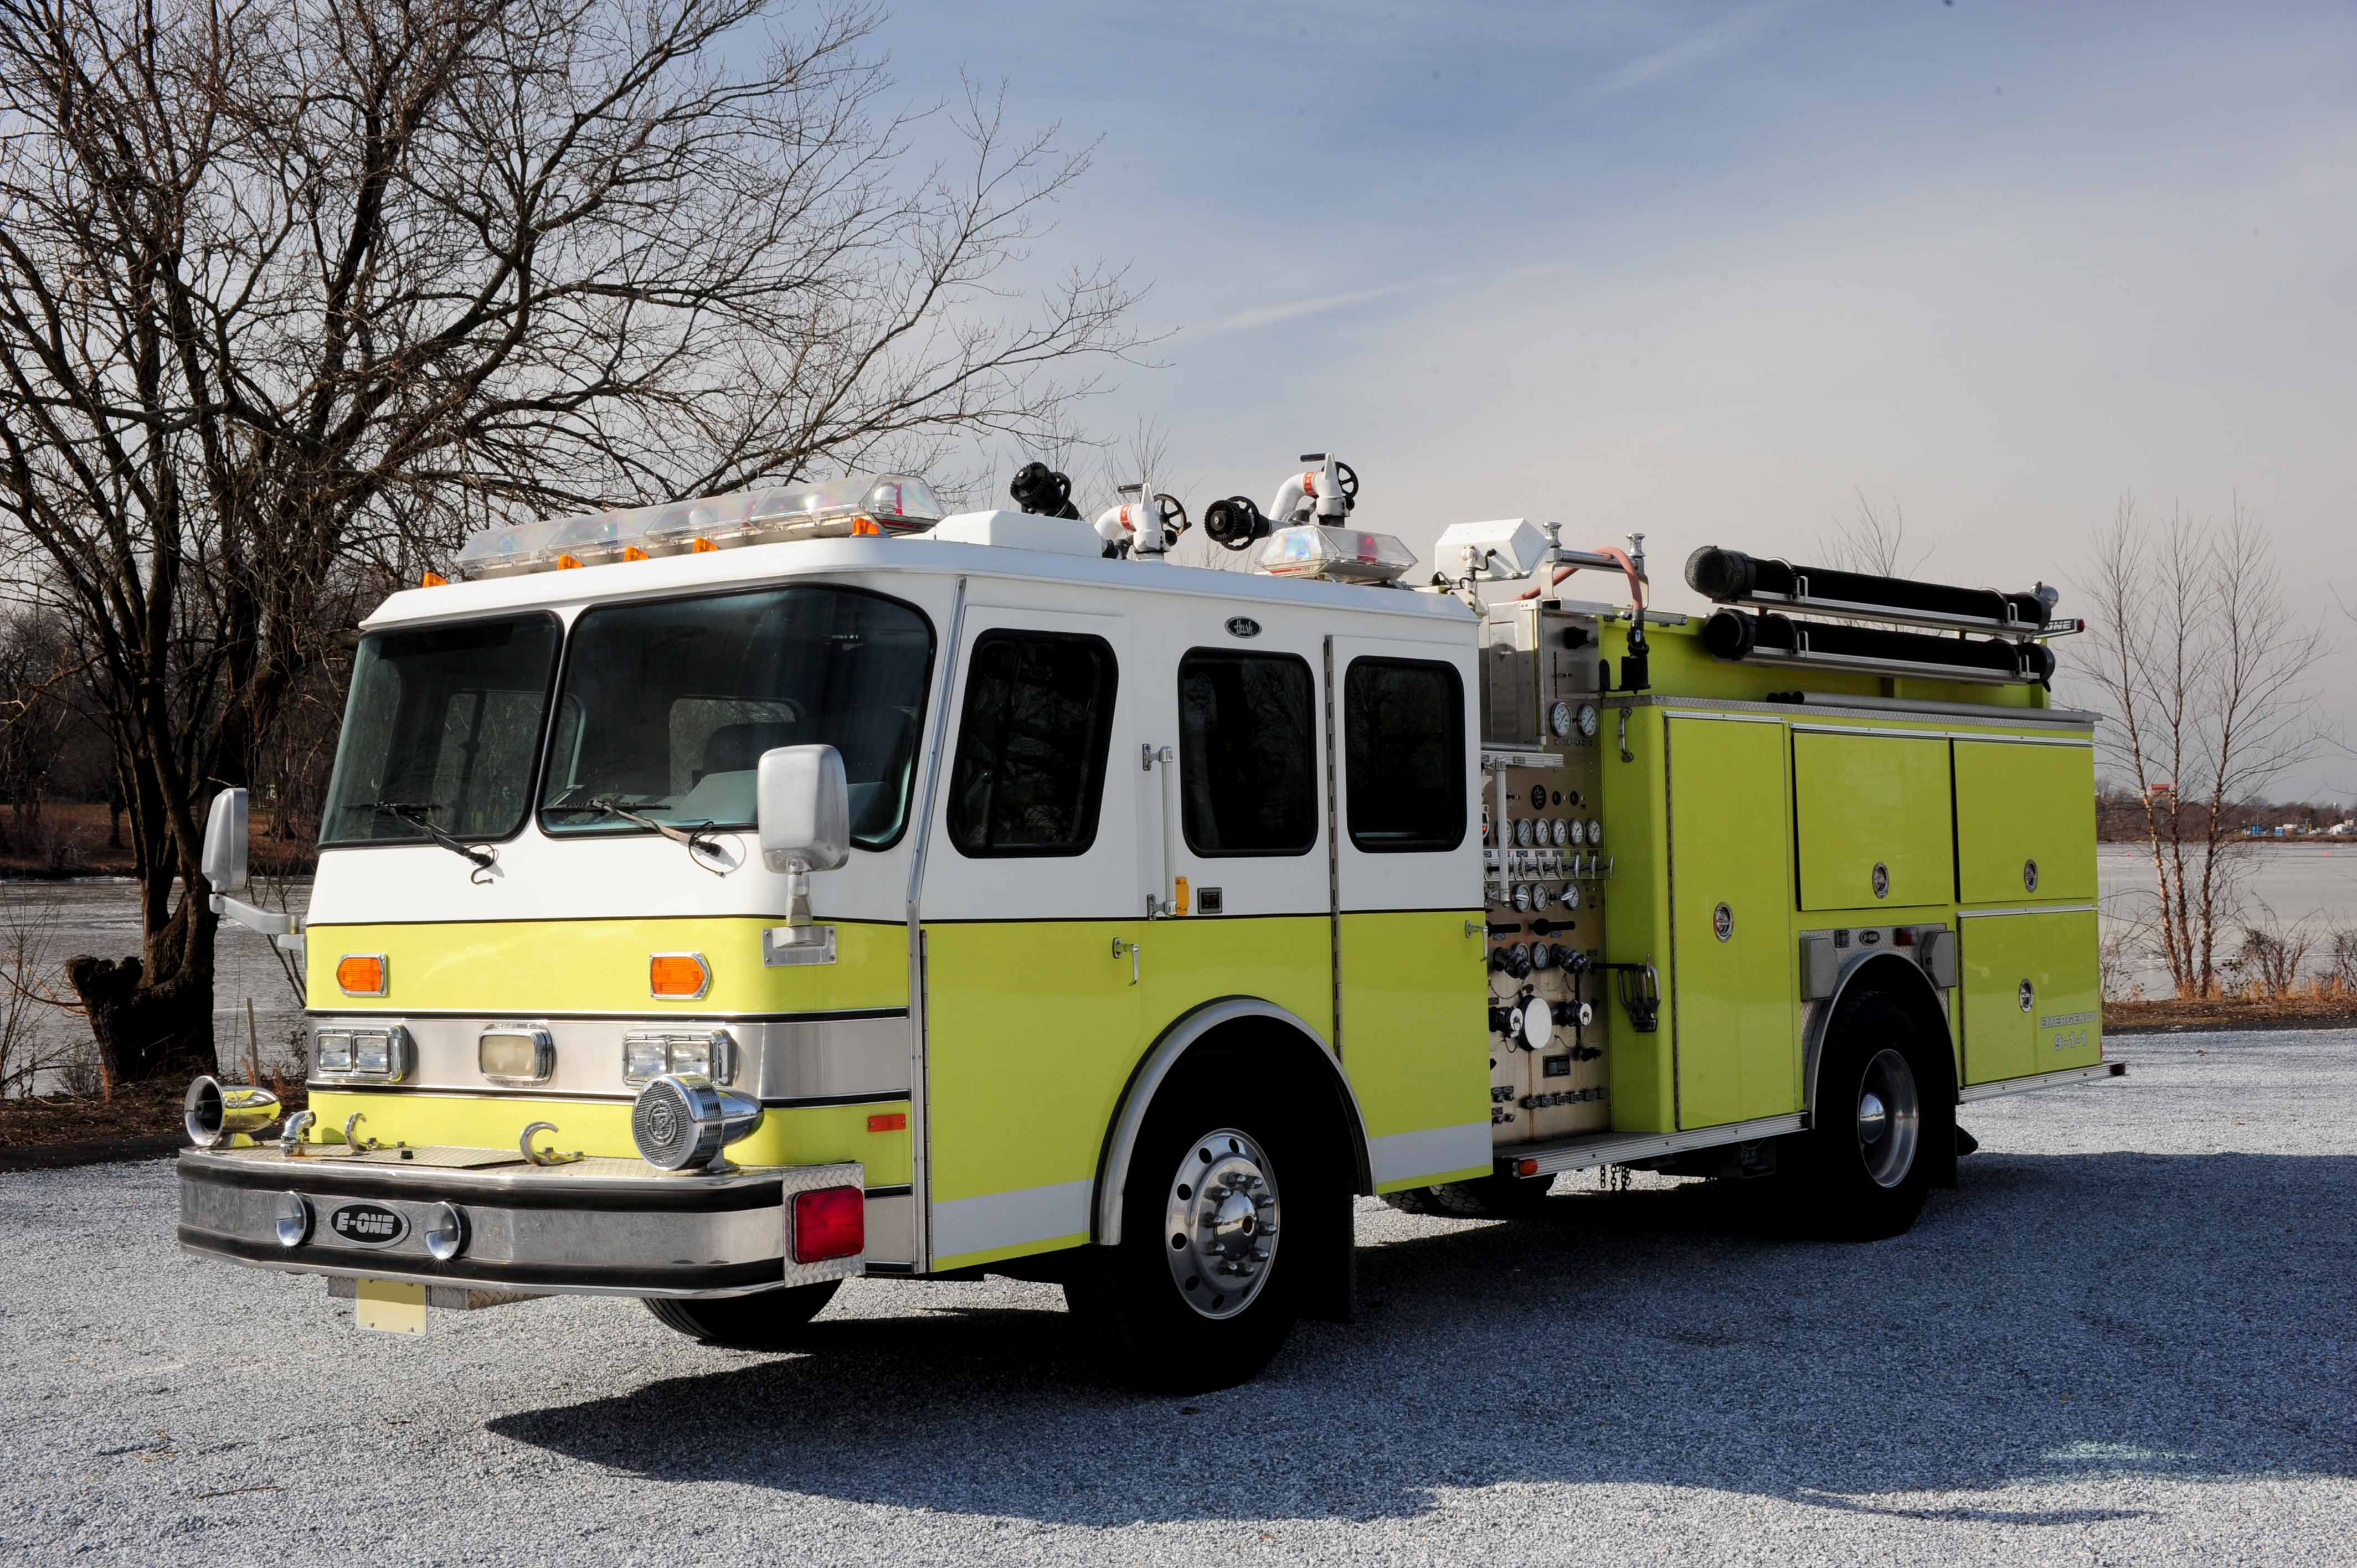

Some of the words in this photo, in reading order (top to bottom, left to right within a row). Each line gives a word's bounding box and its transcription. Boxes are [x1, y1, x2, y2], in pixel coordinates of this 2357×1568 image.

[1234, 619, 1253, 635] Hush
[2040, 1010, 2097, 1028] EMERGENCY
[2055, 1030, 2087, 1051] 9-1-1
[336, 1213, 394, 1235] E-ONE
